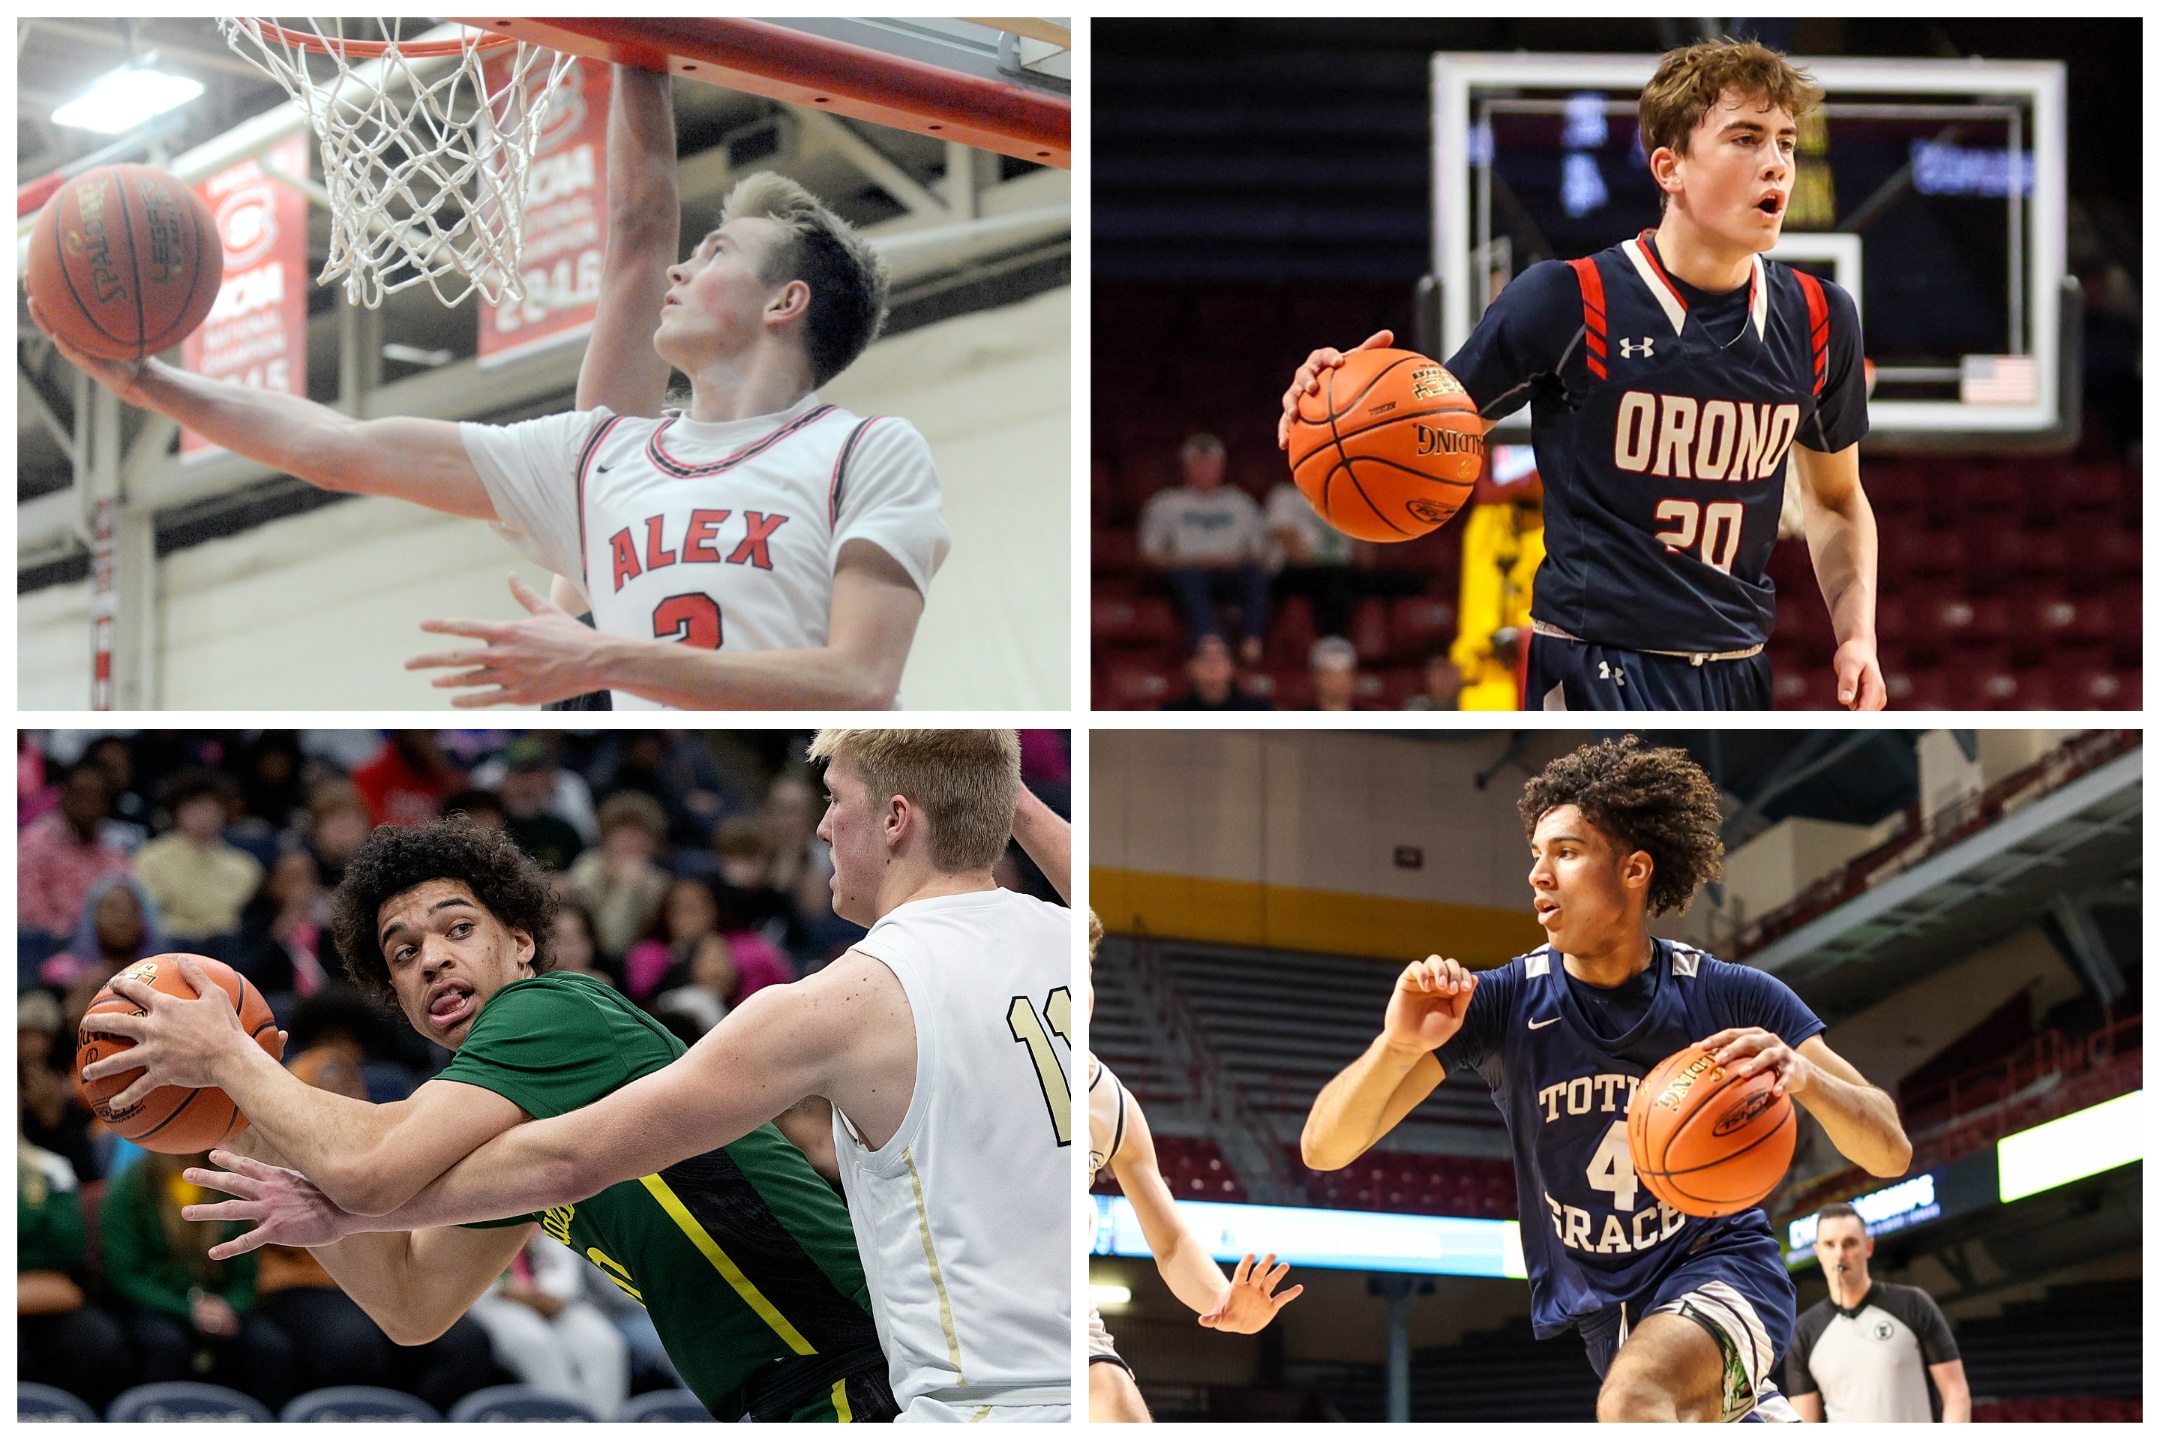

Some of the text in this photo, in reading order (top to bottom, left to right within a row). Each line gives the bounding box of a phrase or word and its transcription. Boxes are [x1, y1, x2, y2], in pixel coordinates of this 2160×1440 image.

[1417, 424, 1483, 457] ALDING
[1615, 390, 1800, 482] ORONO
[609, 508, 789, 594] ALEX
[1655, 497, 1743, 577] 20
[1539, 1073, 1640, 1124] TOTI
[1586, 1119, 1638, 1212] 4
